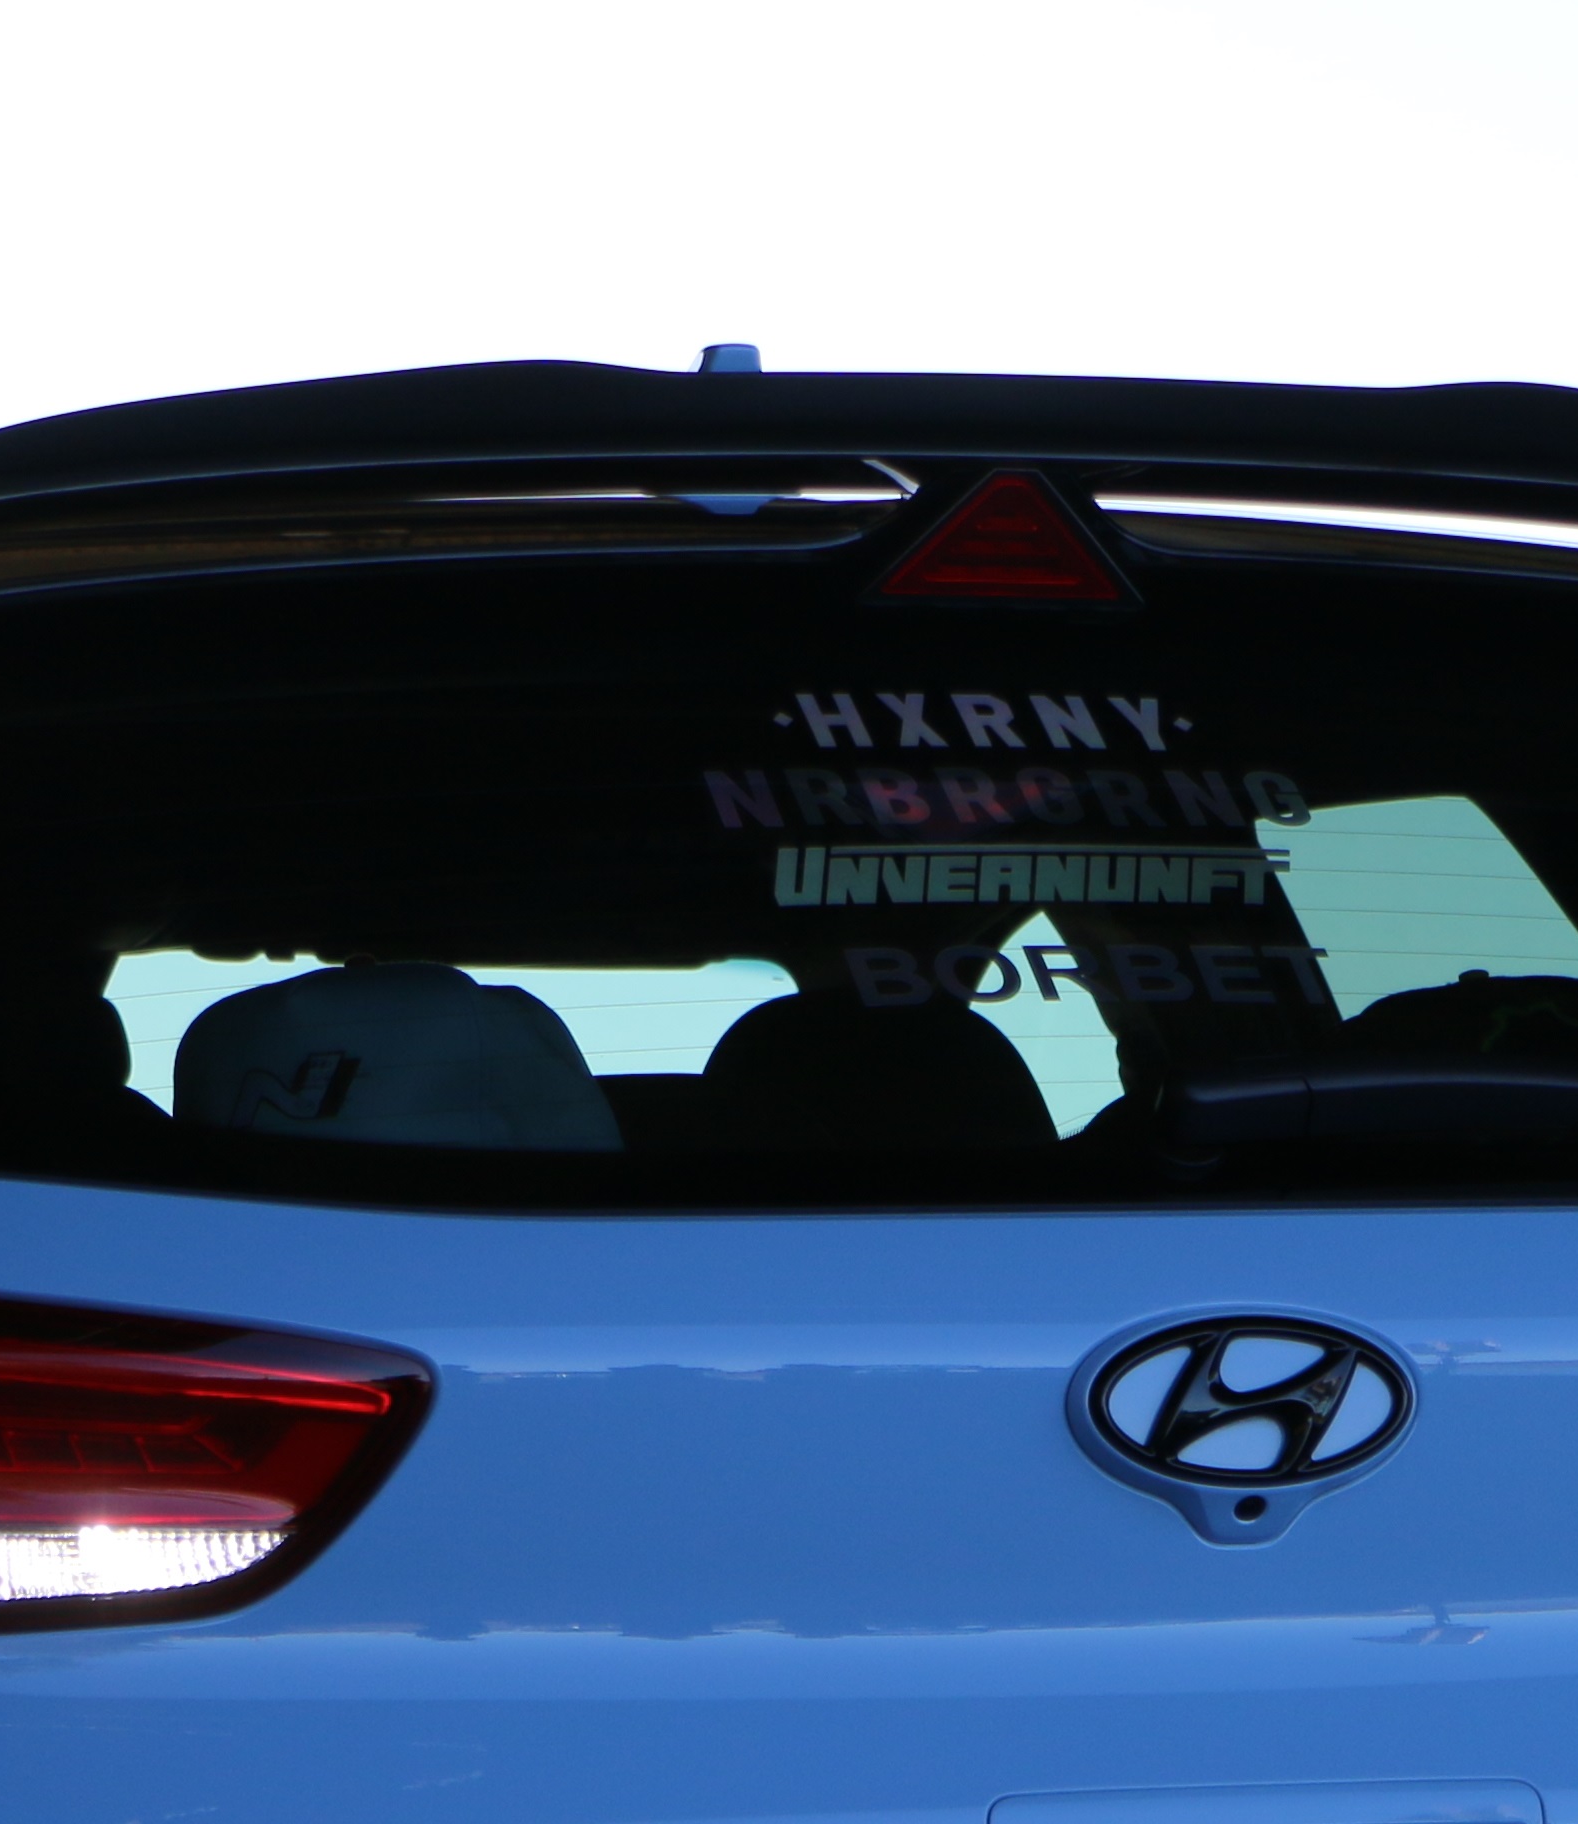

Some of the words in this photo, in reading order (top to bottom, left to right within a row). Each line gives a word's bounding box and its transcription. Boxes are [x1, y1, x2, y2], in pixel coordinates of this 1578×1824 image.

[702, 767, 1312, 828] NRBRGRNG
[774, 844, 1290, 907] UNVERNUNFT
[843, 944, 1328, 1007] BORBET
